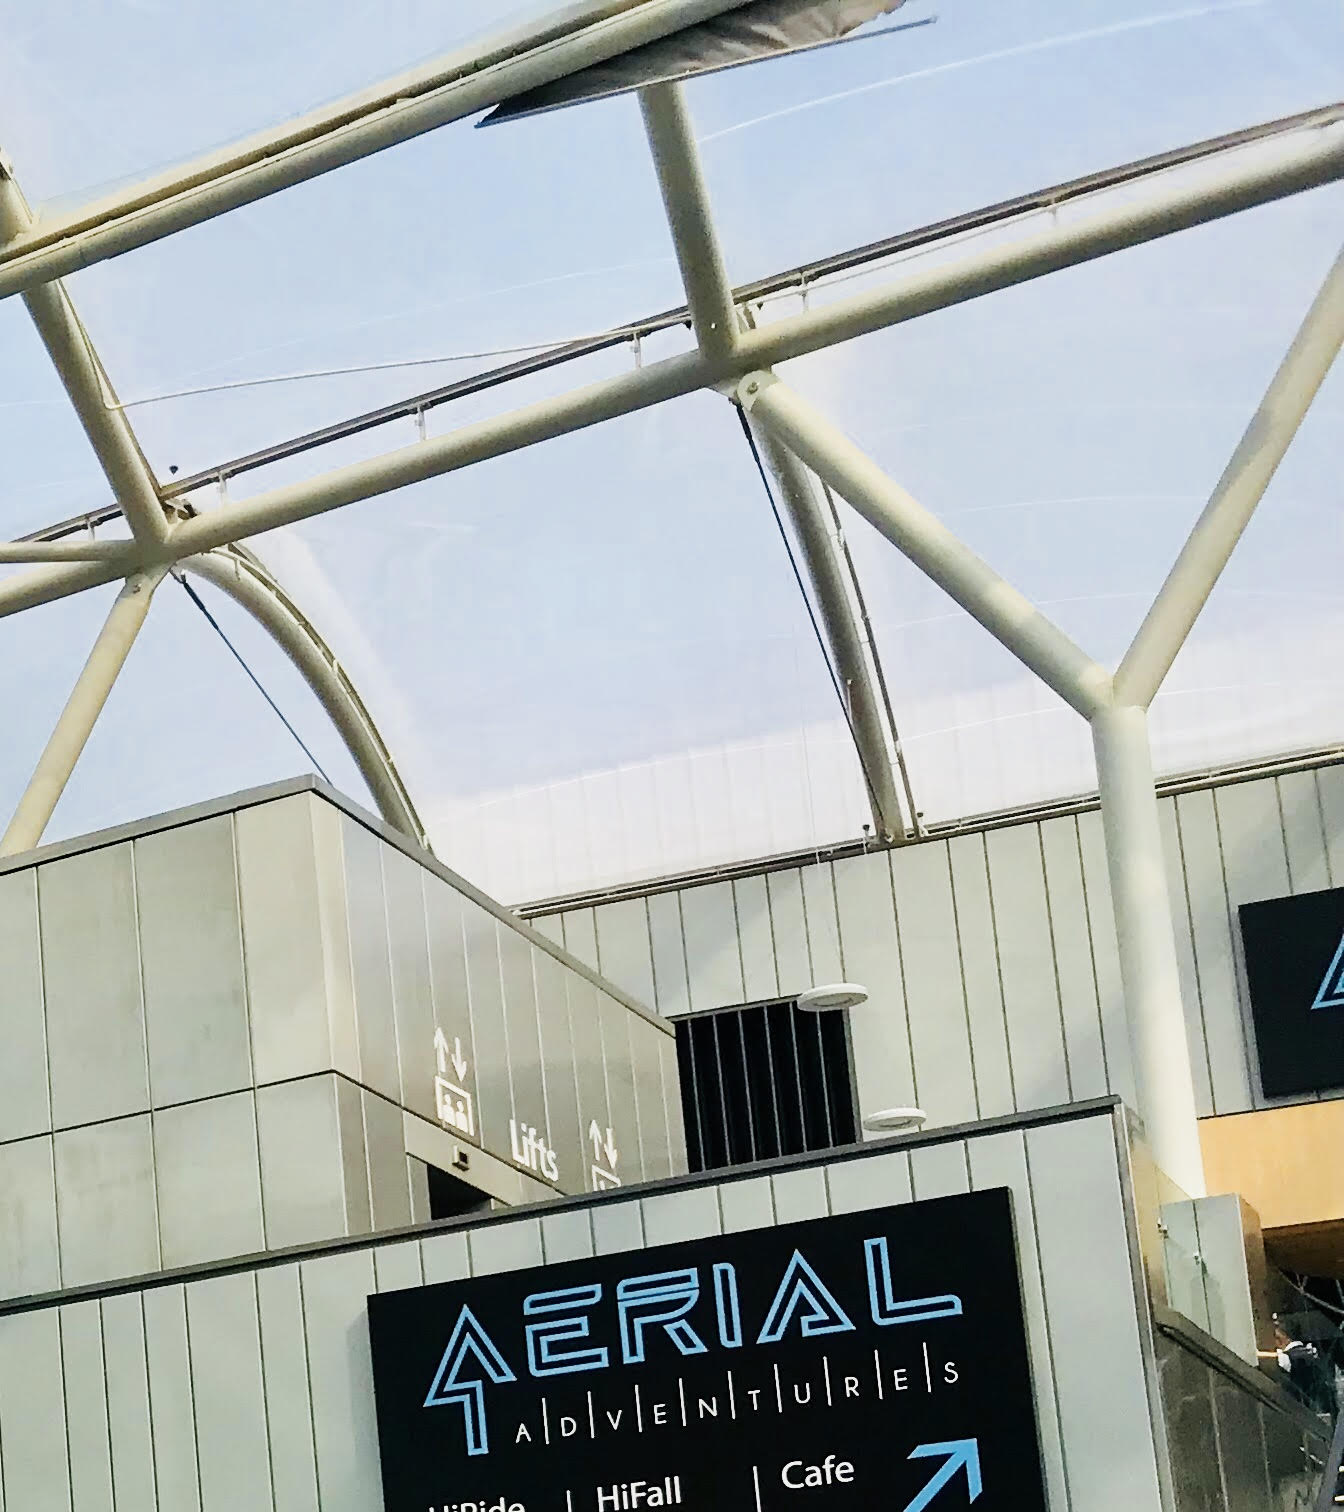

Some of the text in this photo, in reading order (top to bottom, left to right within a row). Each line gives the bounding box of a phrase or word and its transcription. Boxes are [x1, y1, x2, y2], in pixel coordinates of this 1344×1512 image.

[510, 1118, 559, 1183] Lifts
[422, 1236, 964, 1456] AERIAL
[780, 1453, 855, 1491] Cafe
